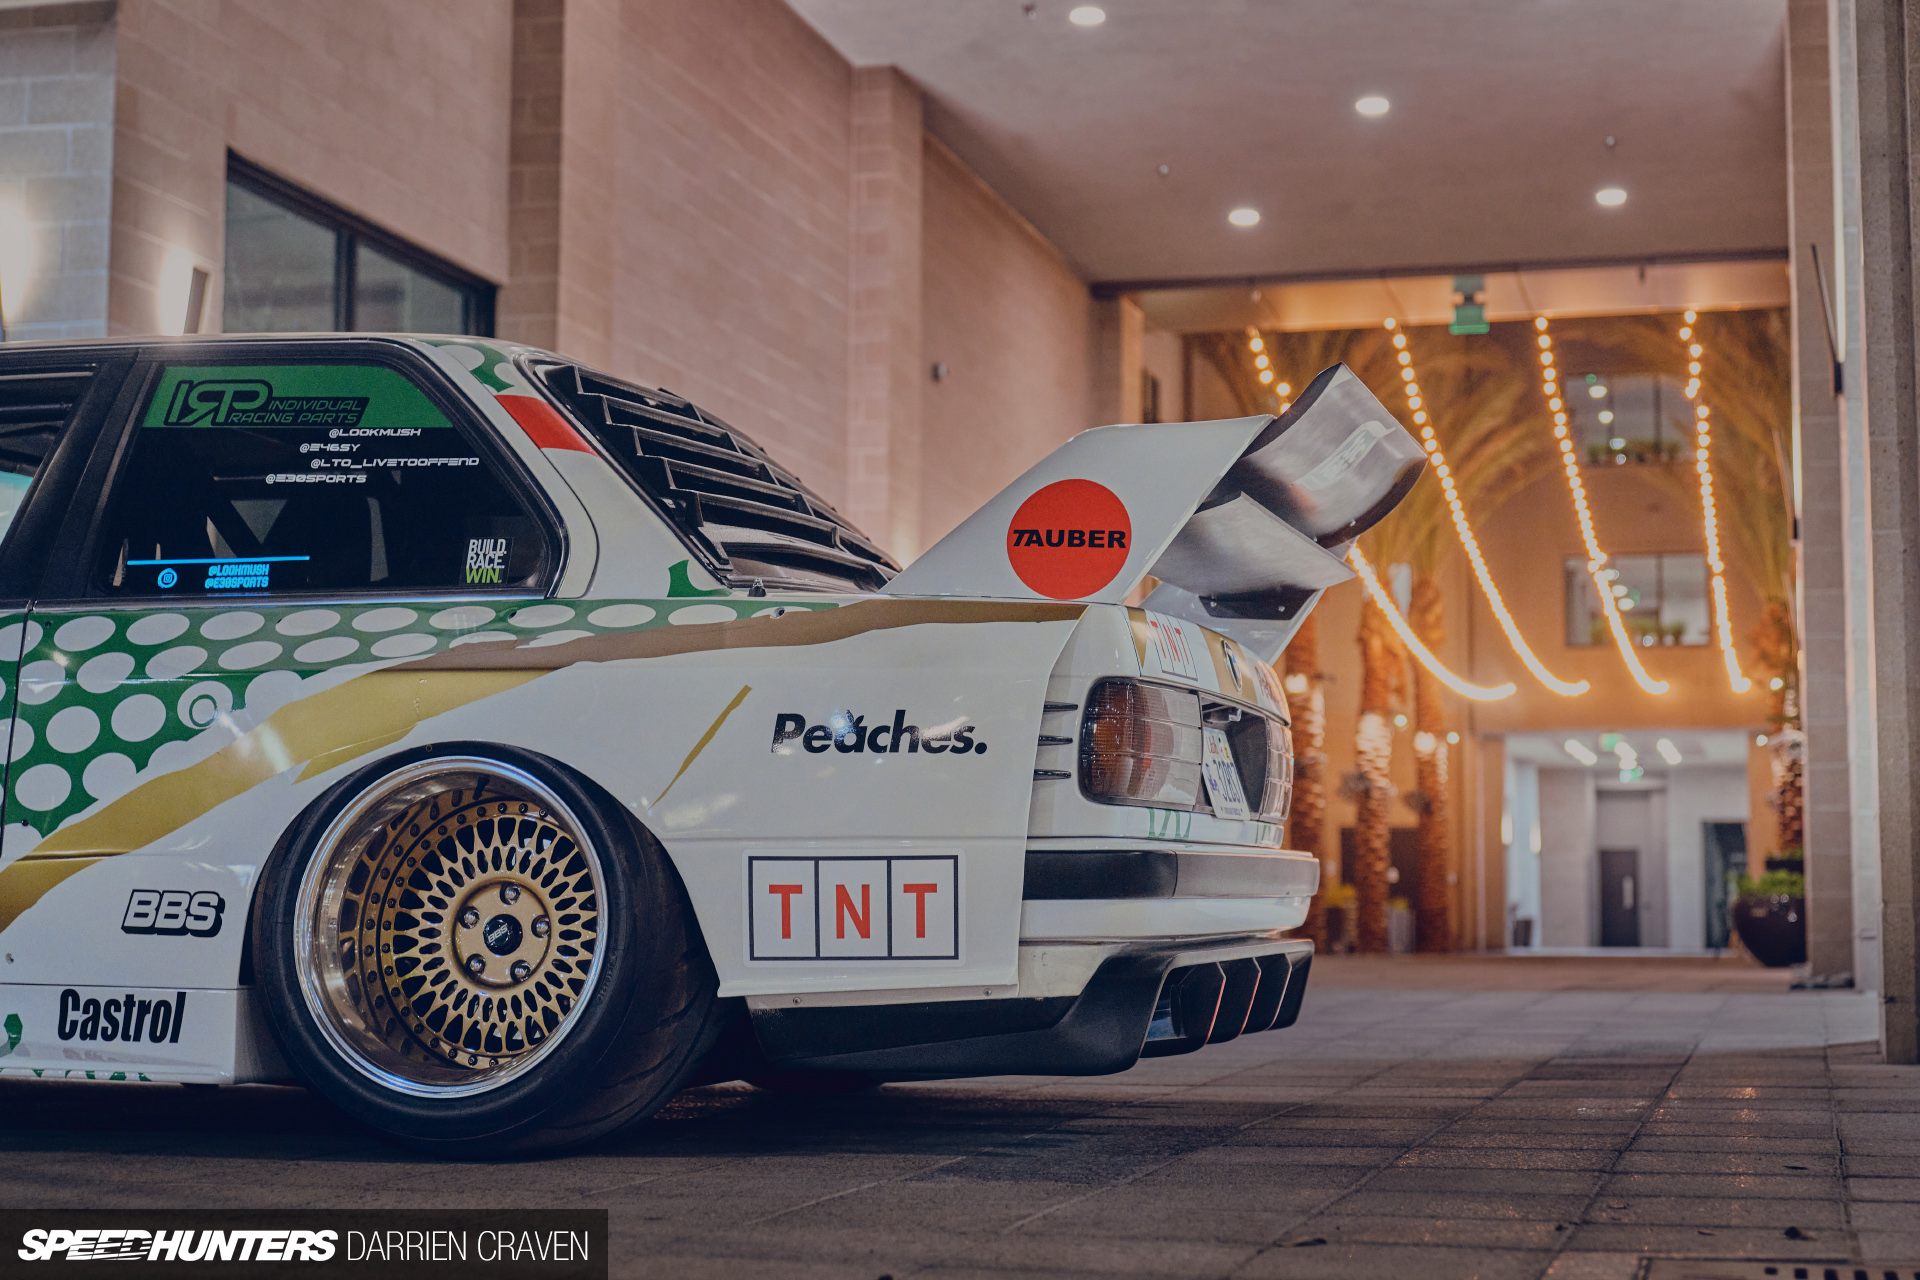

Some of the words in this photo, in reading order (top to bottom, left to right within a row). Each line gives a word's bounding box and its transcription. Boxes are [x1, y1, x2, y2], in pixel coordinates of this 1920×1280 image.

[268, 400, 361, 411] INDIVIDUAL
[228, 412, 292, 423] RACING
[298, 412, 358, 423] PARTS
[329, 428, 421, 438] @LOOKMUSH
[300, 443, 360, 453] @E46SY
[265, 474, 367, 484] @E30SPORTS
[468, 538, 507, 554] BUILD.
[1013, 529, 1126, 548] TAUBER
[466, 553, 505, 569] RACE.
[466, 568, 502, 583] WIN.
[771, 709, 988, 754] Peaches.
[121, 889, 225, 937] BBS
[768, 883, 938, 940] TNT
[487, 923, 509, 944] BBS
[57, 988, 187, 1043] Castrol
